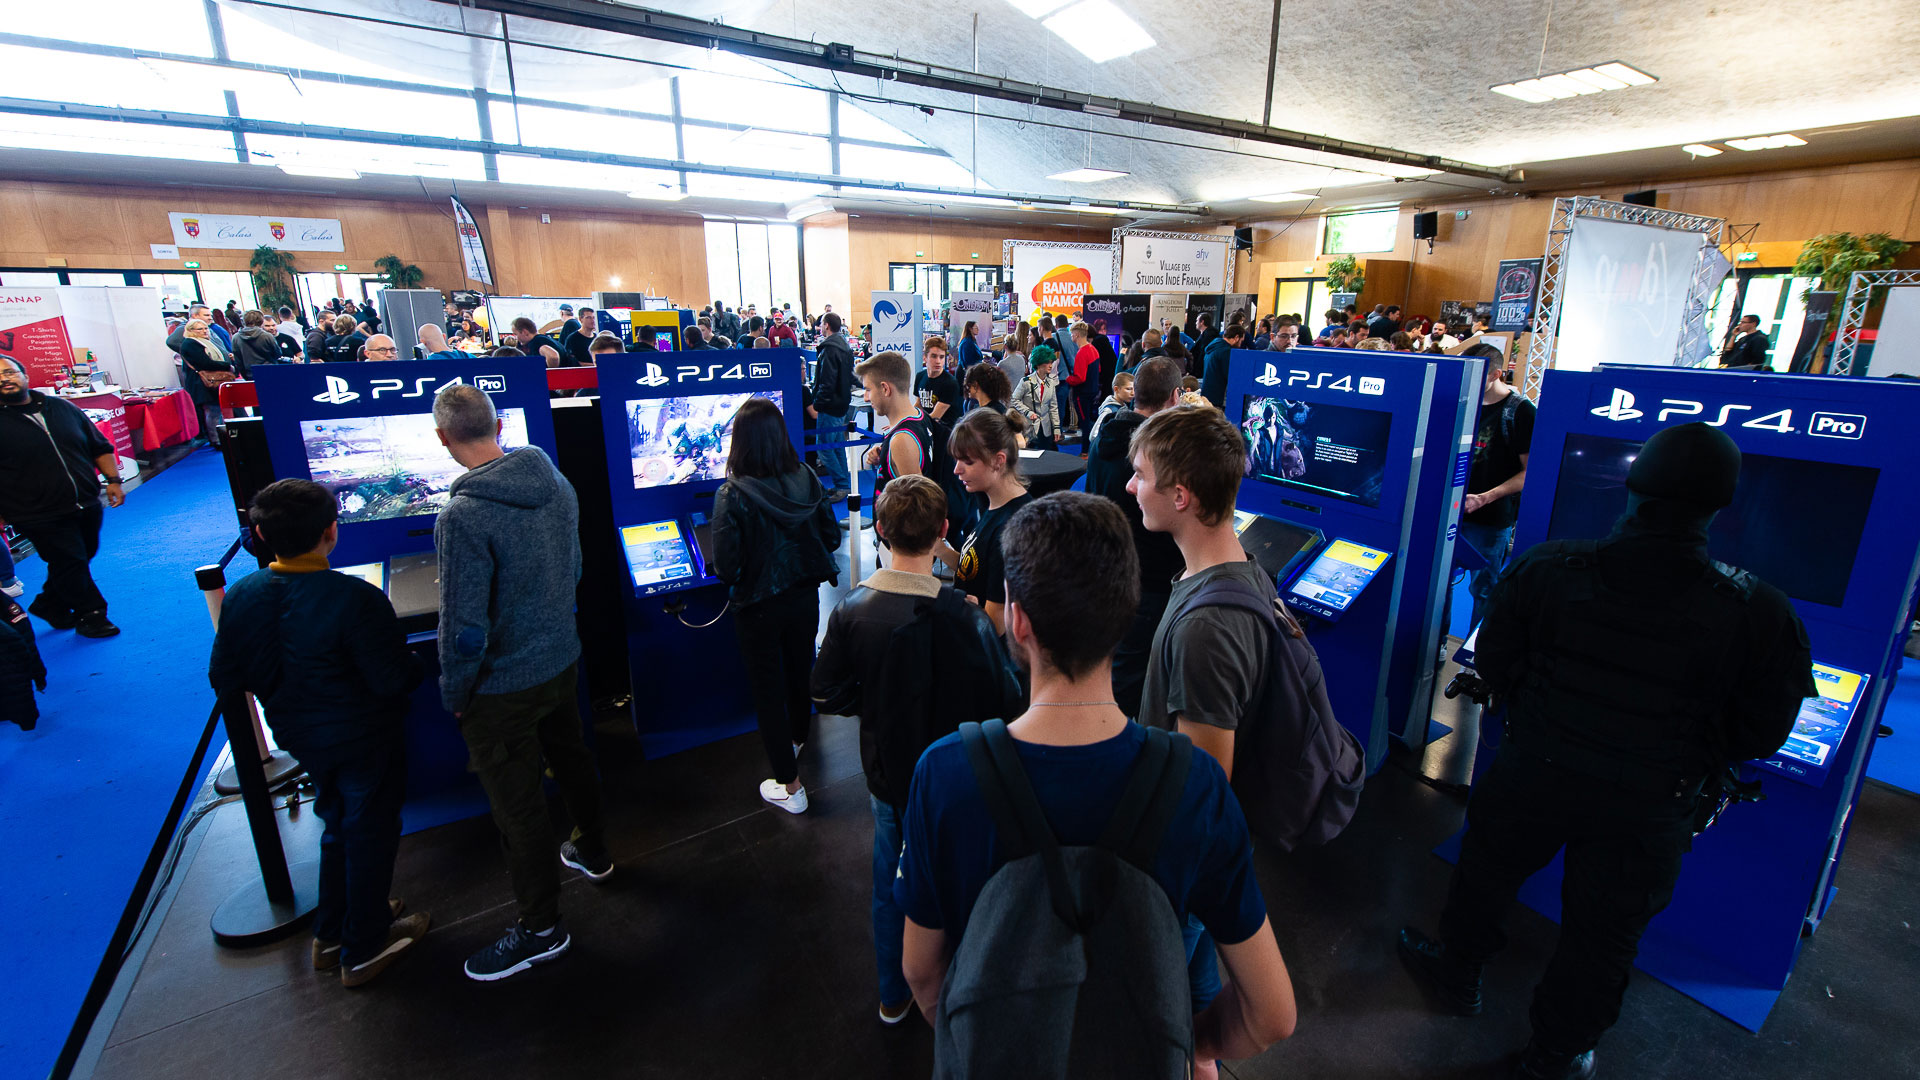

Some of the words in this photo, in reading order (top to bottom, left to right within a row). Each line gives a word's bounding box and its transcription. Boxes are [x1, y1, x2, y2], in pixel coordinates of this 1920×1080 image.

[217, 225, 252, 239] Calais
[301, 229, 333, 242] Calais
[1196, 248, 1210, 261] afjv
[1160, 260, 1181, 271] VILLAGE
[1136, 271, 1164, 285] STUDIOS
[1181, 273, 1211, 288] FRANÇAIS
[1043, 282, 1087, 294] BANDAI
[1497, 307, 1526, 320] 100%
[876, 342, 912, 352] GAME
[675, 363, 746, 383] PS4
[752, 366, 769, 376] Pro
[478, 378, 502, 390] Pro
[1288, 369, 1354, 393] PS4
[1362, 380, 1382, 392] Pro
[1657, 398, 1796, 433] PS4
[1816, 417, 1857, 434] Pro
[657, 582, 683, 591] PS4
[1299, 601, 1323, 613] PS4
